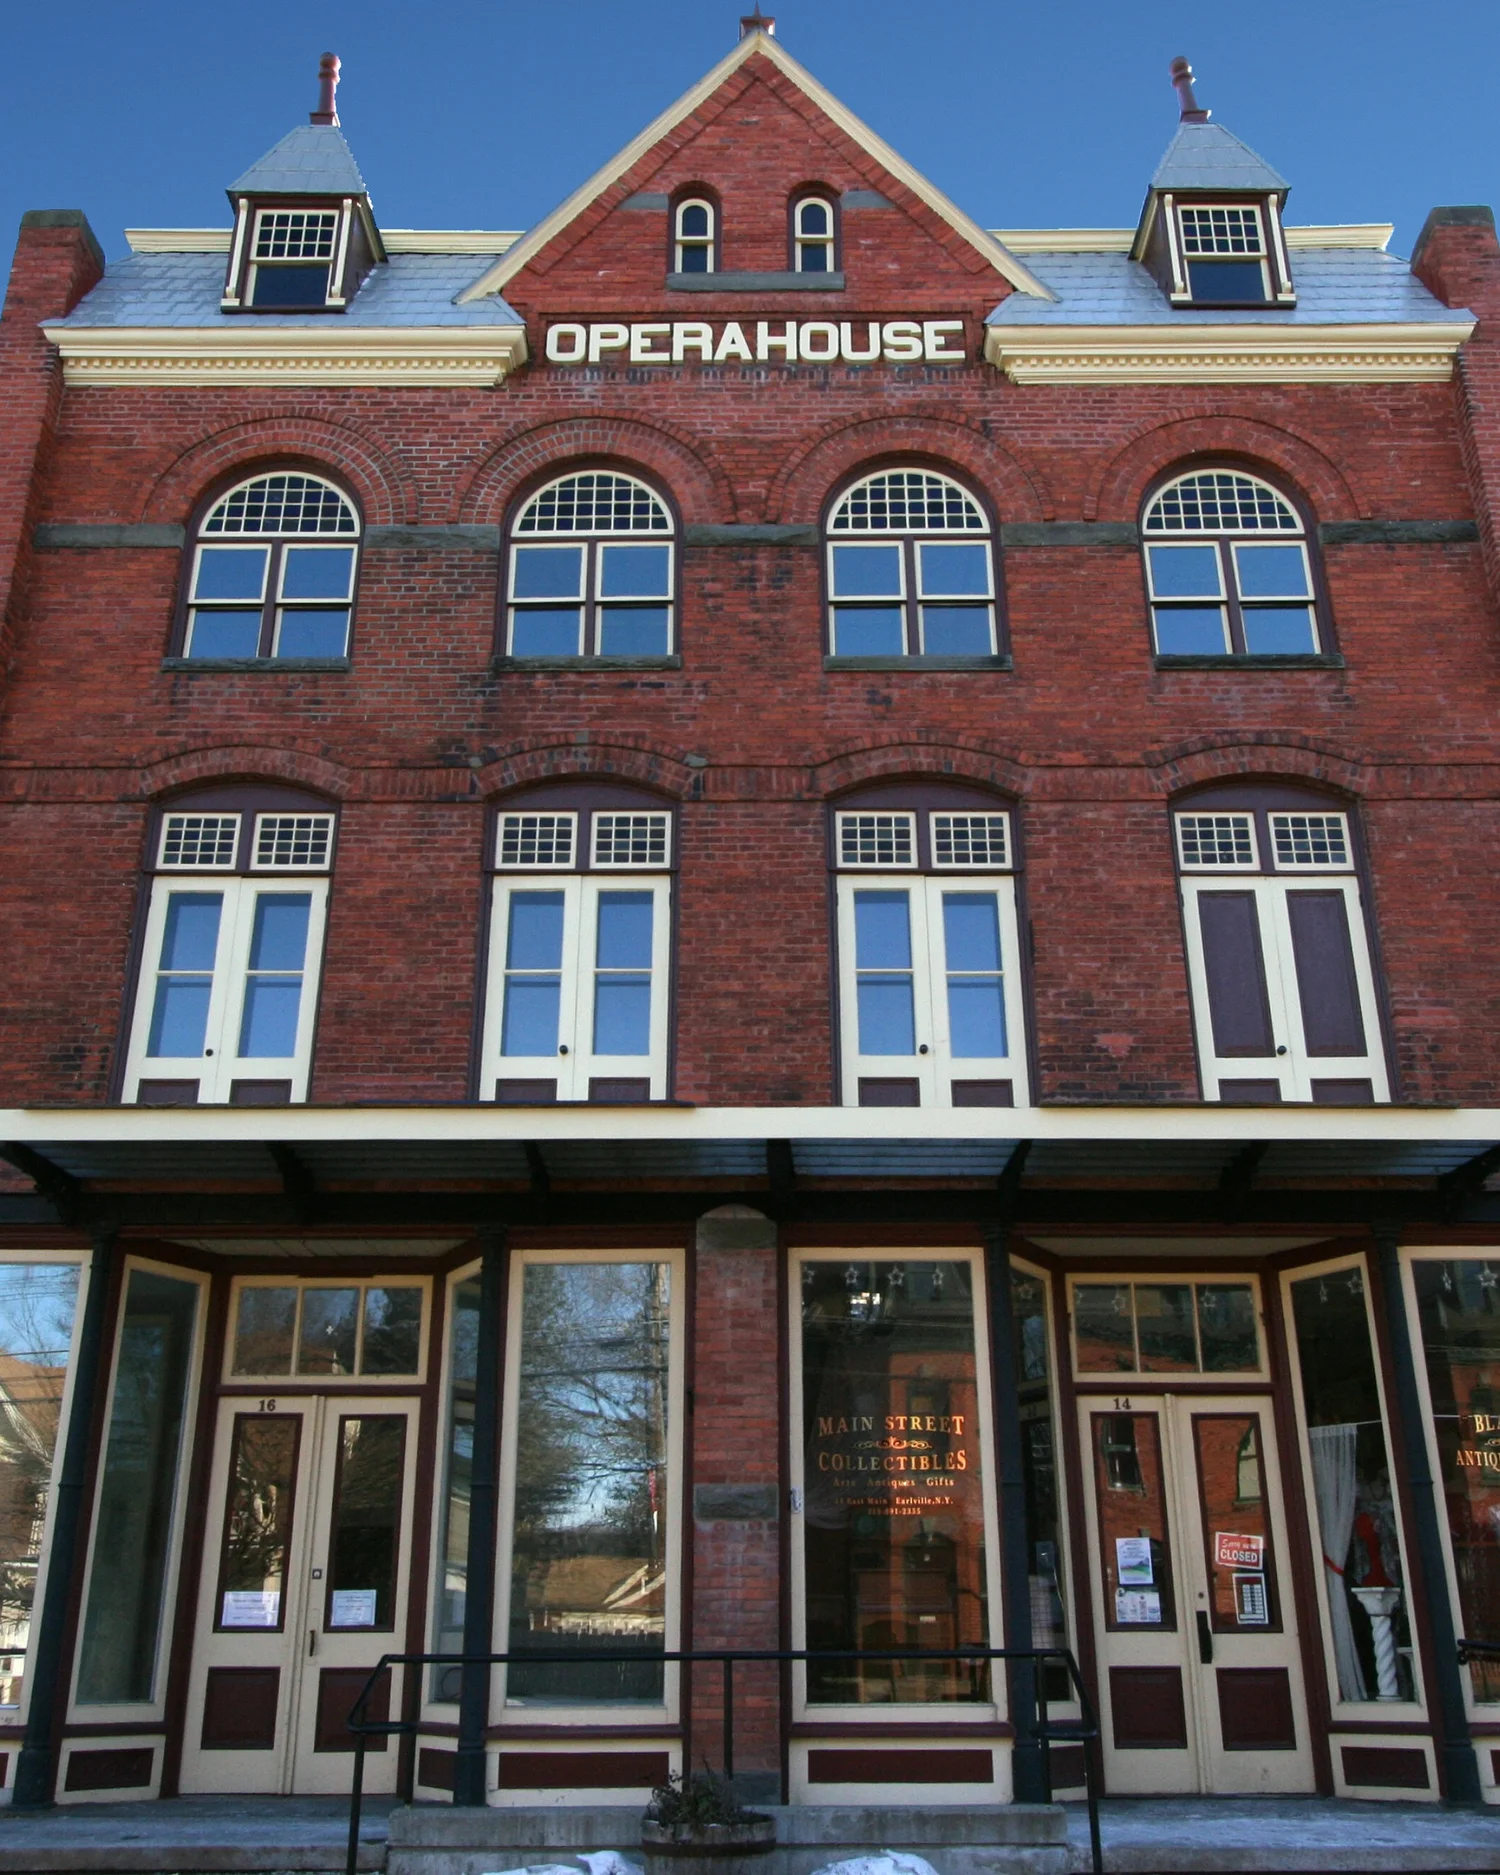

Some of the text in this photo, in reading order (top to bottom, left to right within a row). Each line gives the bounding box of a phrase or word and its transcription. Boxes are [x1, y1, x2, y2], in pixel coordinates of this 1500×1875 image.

[259, 1399, 276, 1412] 16
[1113, 1397, 1131, 1410] 14
[818, 1415, 965, 1437] MAIN STREET
[818, 1449, 967, 1471] COLLECTIBLES
[1456, 1450, 1500, 1472] ANTIQ
[866, 1476, 915, 1489] Antiques
[926, 1476, 955, 1487] Gifts
[1220, 1548, 1258, 1563] CLOSED
